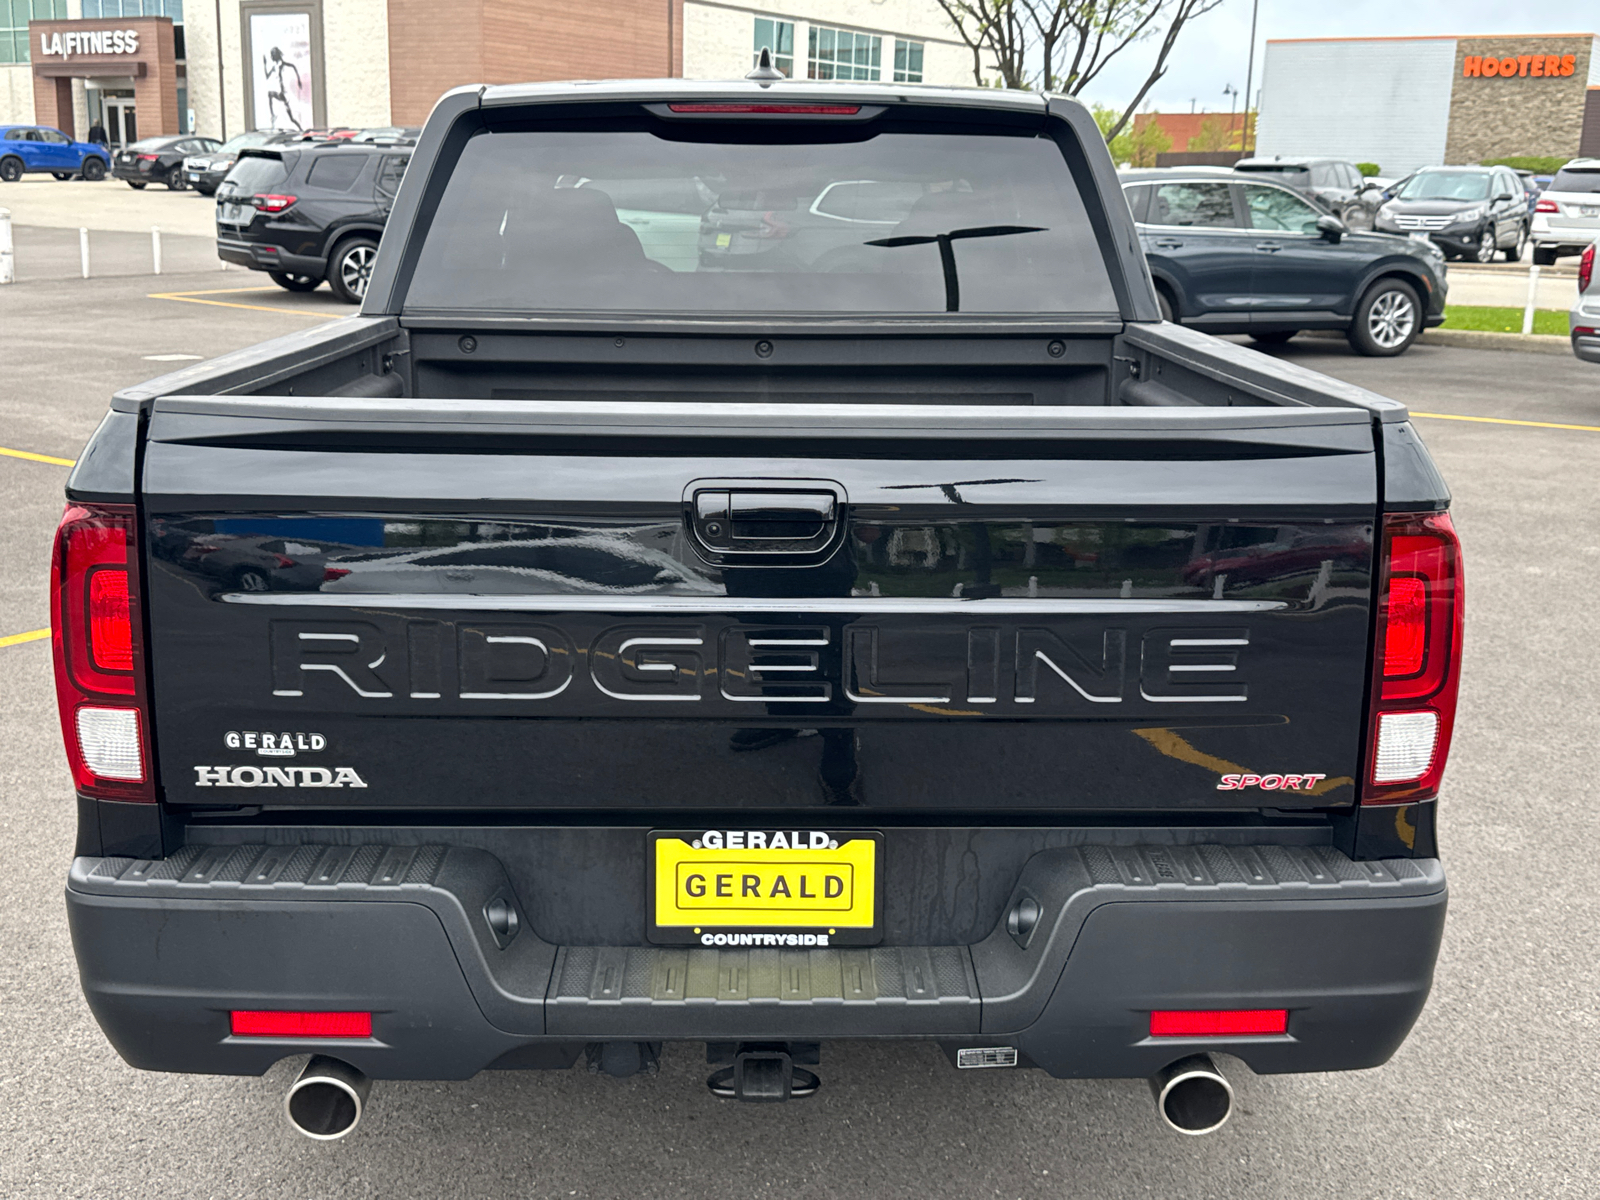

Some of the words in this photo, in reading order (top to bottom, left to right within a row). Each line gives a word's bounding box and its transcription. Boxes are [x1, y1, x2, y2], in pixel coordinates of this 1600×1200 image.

[1463, 54, 1576, 77] HOOTERS
[271, 619, 1249, 703] RIDGELINE
[226, 732, 325, 750] GERALD
[194, 765, 368, 788] HONDA
[1216, 773, 1327, 790] SPORT
[701, 830, 830, 850] GERALD
[685, 873, 844, 899] GERALD
[701, 933, 829, 946] COUNTRYSIDE
